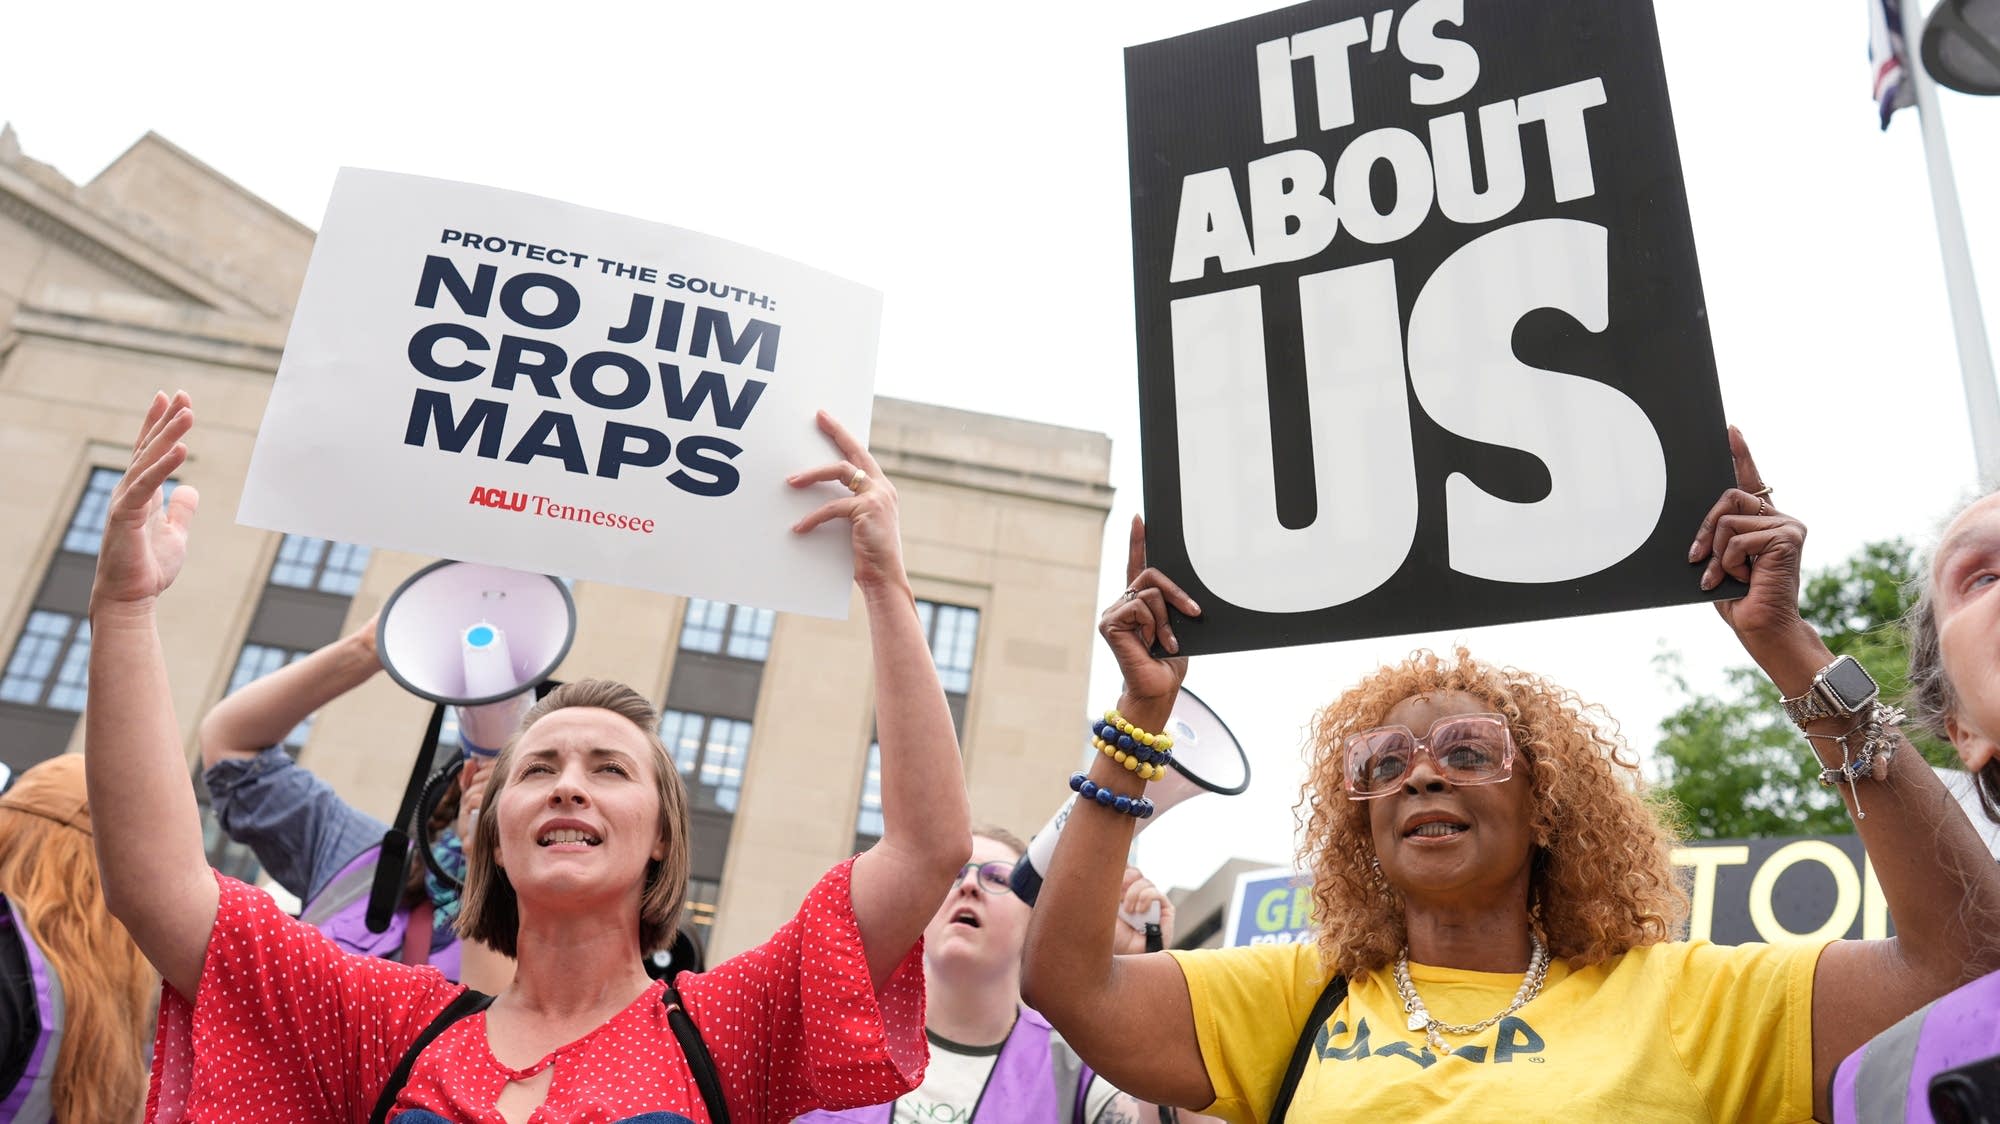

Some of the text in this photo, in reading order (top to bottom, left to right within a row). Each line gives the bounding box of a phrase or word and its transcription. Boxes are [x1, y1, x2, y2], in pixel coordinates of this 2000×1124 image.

[1256, 0, 1480, 144] IT'S
[1170, 77, 1607, 283] ABOUT
[414, 254, 782, 373] NO JIM
[440, 228, 777, 312] PROTECT THE SOUTH:
[407, 322, 768, 430] CROW
[1170, 218, 1667, 613] US
[404, 388, 744, 497] MAPS
[469, 485, 656, 534] ACLU Tennessee
